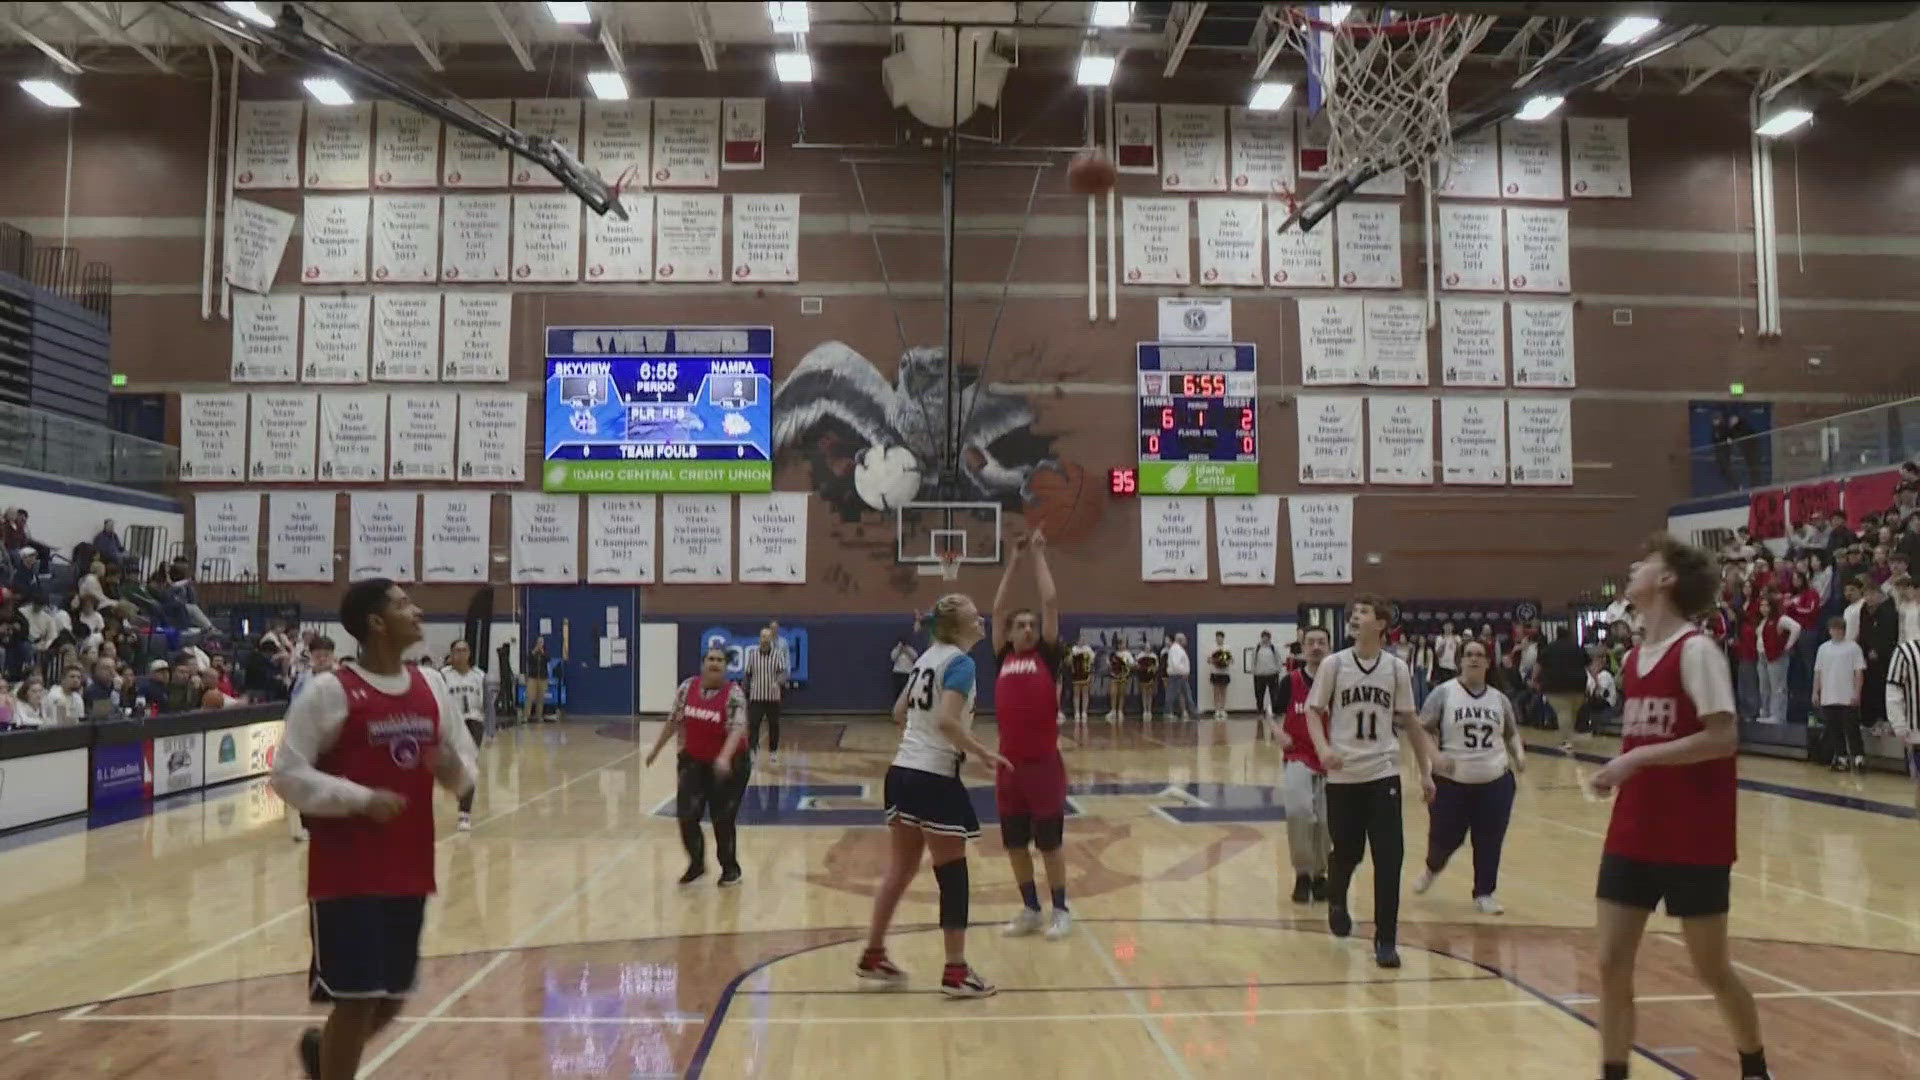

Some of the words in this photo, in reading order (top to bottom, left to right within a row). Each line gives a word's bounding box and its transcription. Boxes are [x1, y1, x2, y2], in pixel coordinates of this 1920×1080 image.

[555, 361, 611, 374] SKYVIEW
[711, 361, 755, 374] NAMPA
[637, 381, 675, 392] PERIOD
[734, 381, 742, 396] 2
[1183, 374, 1225, 397] 6:55
[1162, 409, 1174, 429] 6
[1199, 411, 1203, 427] 1
[1241, 409, 1253, 429] 2
[1149, 436, 1159, 452] 0
[1243, 436, 1253, 452] 0
[620, 445, 653, 458] TEAM
[657, 445, 697, 458] FOULS
[573, 468, 613, 480] IDAHO
[617, 468, 676, 480] CENTRAL
[680, 468, 723, 480] CREDIT
[728, 468, 771, 480] UNION
[1112, 470, 1135, 492] 35
[1196, 475, 1235, 486] Central
[610, 514, 633, 522] State
[1162, 513, 1185, 522] State
[1236, 514, 1258, 523] State
[1310, 517, 1332, 525] State
[595, 539, 648, 549] Champions
[673, 537, 721, 546] Champions
[748, 536, 797, 546] Champions
[1148, 538, 1200, 549] Champions
[1221, 540, 1273, 550] Champions
[1296, 540, 1347, 550] Champions
[908, 667, 935, 711] 23
[1341, 686, 1391, 710] HAWKS
[684, 704, 721, 723] NAMPA
[1454, 706, 1500, 725] HAWKS
[1355, 710, 1378, 741] 11
[1463, 724, 1494, 749] 52
